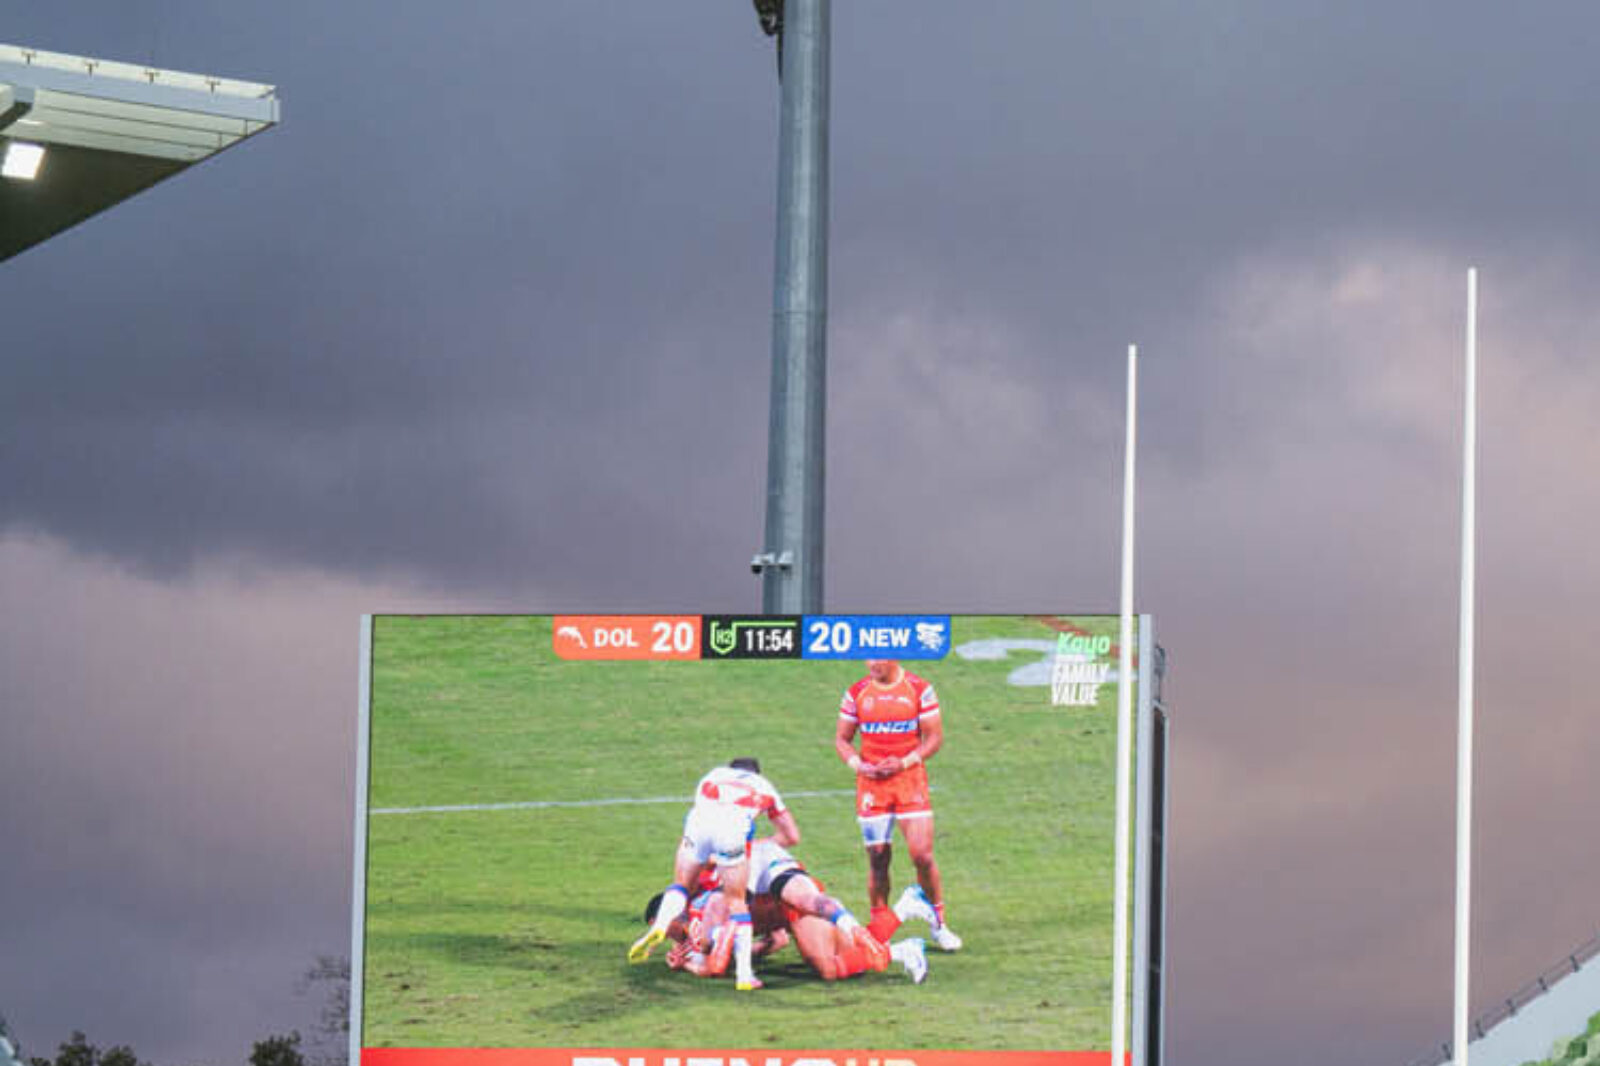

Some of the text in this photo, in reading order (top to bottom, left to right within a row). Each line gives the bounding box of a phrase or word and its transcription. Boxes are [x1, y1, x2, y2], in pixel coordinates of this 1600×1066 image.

[593, 622, 694, 653] DOL 20
[745, 629, 793, 652] 11:54
[808, 622, 911, 653] 20 NEW
[1057, 631, 1110, 662] Kayo
[1053, 662, 1109, 683] FAMILY
[1051, 683, 1099, 705] VALUE
